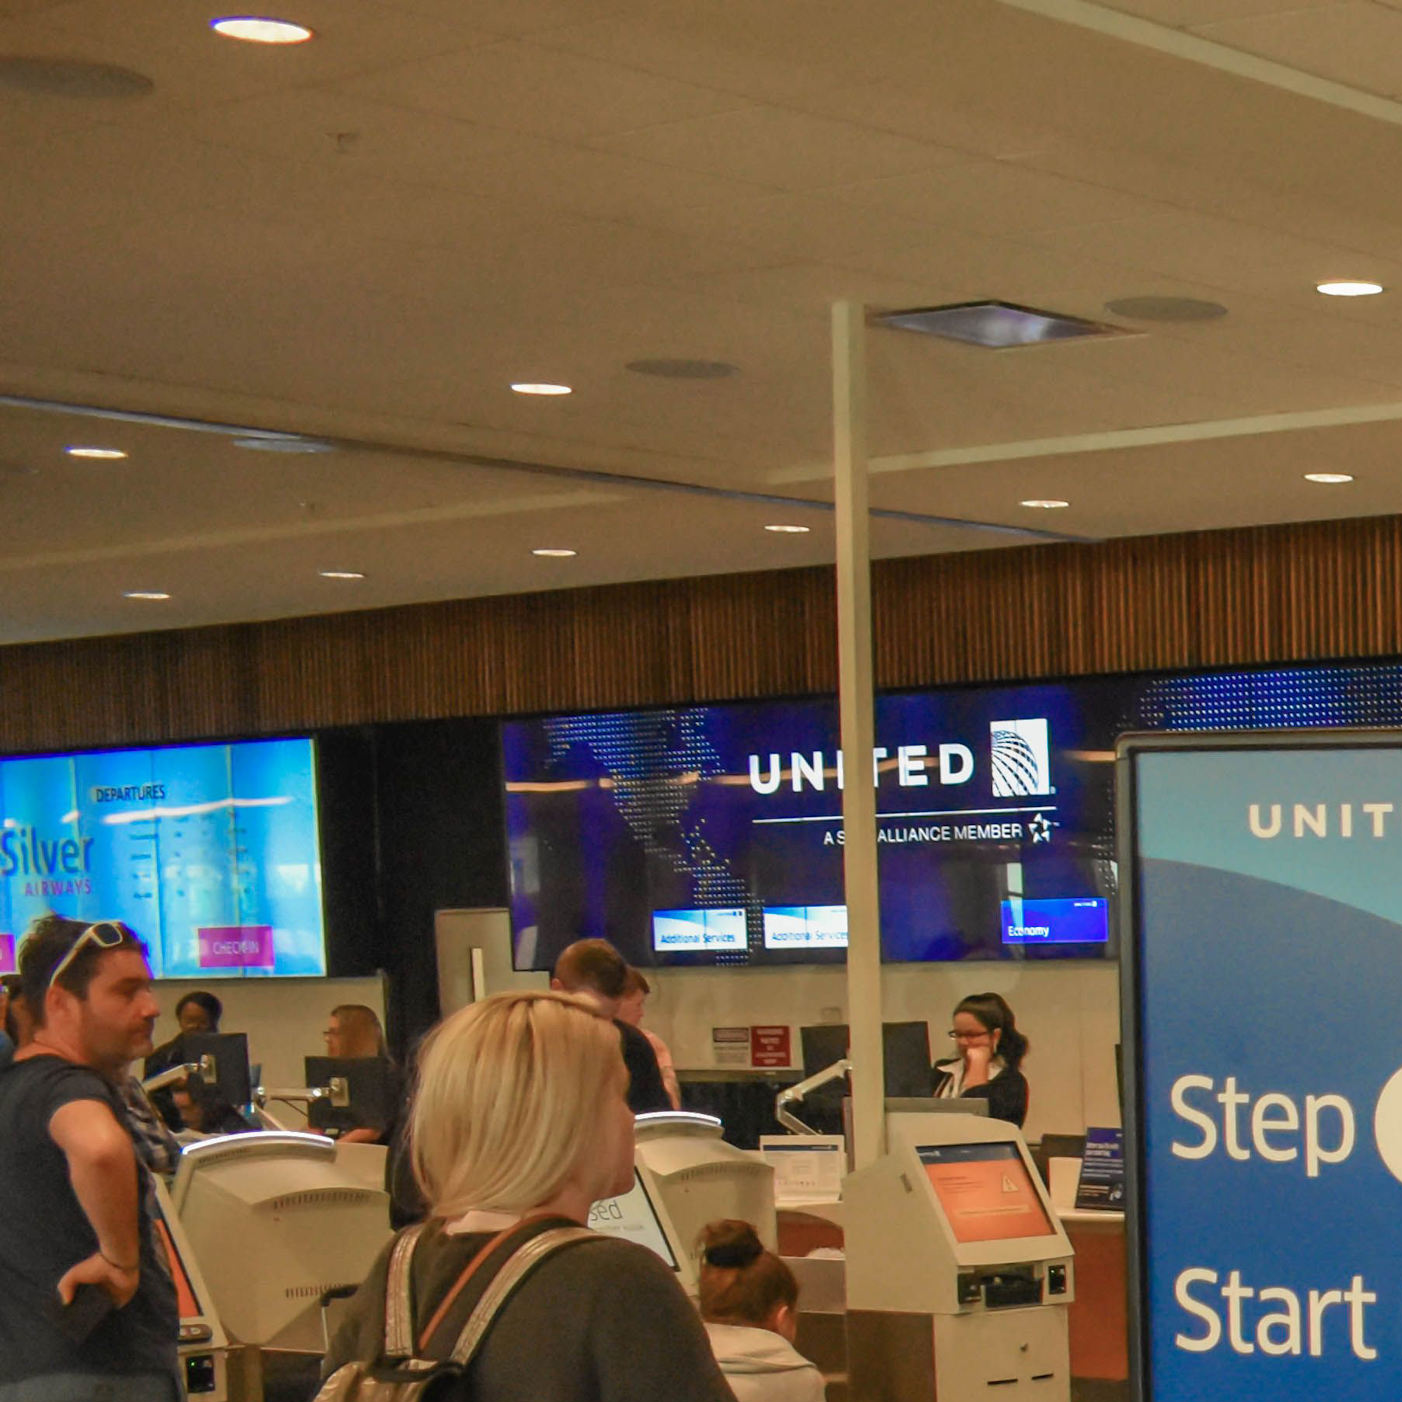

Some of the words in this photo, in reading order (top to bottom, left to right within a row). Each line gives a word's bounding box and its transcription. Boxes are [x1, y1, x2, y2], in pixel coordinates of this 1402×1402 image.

[95, 784, 166, 802] DEPARTURES
[823, 832, 834, 845] A
[877, 826, 950, 843] ALLIANCE
[954, 823, 1023, 840] MEMBER
[0, 825, 94, 877] Silver
[25, 879, 92, 896] AIRWAYS
[703, 932, 736, 944] Services
[1008, 926, 1049, 938] Economy
[1170, 1074, 1356, 1177] Step
[590, 1200, 623, 1221] sed
[1174, 1267, 1378, 1361] Start
